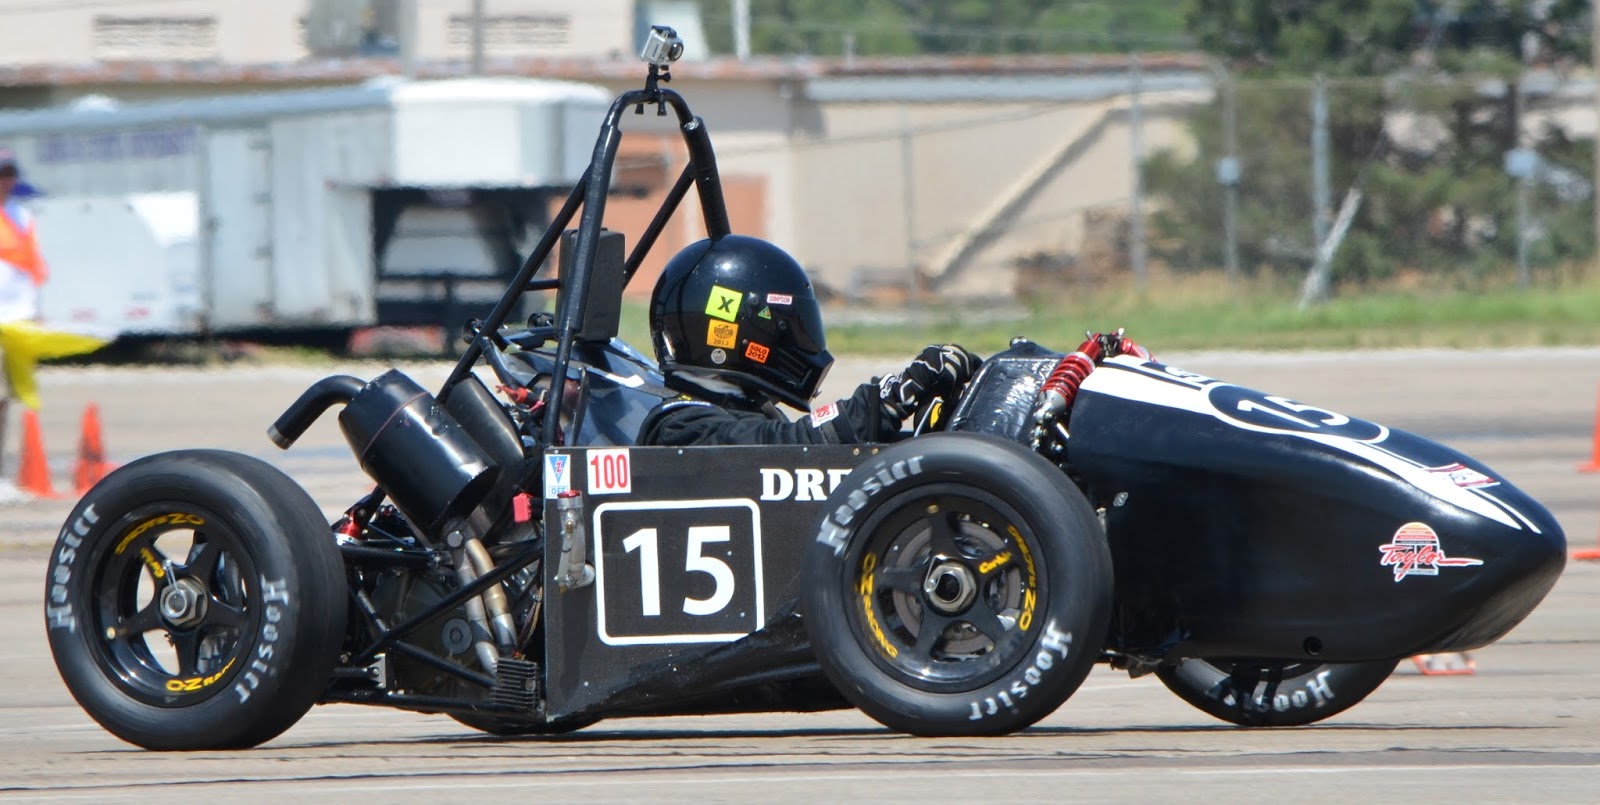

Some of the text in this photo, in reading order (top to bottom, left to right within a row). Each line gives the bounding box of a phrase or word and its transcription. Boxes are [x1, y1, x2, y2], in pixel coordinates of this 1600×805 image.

[717, 295, 735, 313] X
[748, 351, 765, 360] 2012
[750, 345, 767, 355] SOLO
[1237, 395, 1350, 428] 15
[590, 454, 628, 489] 100
[816, 454, 925, 556] Hoosier
[47, 503, 100, 634] Hoosier
[622, 525, 735, 616] 15
[1380, 545, 1480, 581] Taylor
[235, 574, 289, 703] Hoosier
[968, 617, 1073, 721] Hoosier
